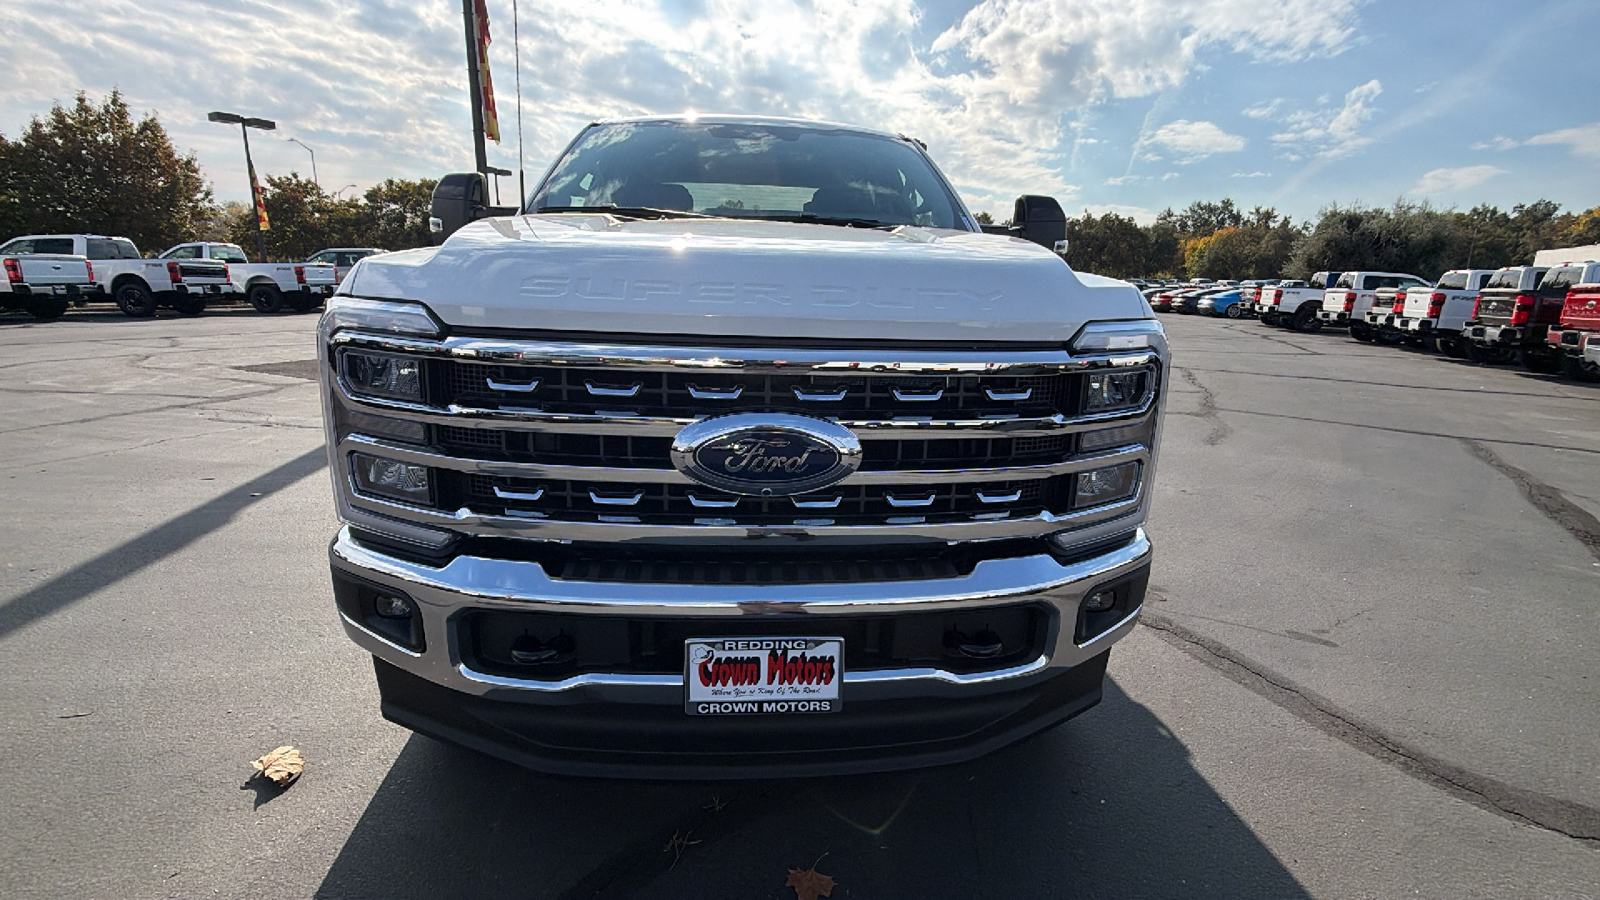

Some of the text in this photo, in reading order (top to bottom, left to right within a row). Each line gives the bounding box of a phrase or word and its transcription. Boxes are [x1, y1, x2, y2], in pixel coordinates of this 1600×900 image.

[519, 275, 1003, 311] SUPER DUTY
[724, 438, 811, 473] Ford
[724, 640, 806, 650] REDDING
[698, 650, 835, 687] Crown Motors
[711, 687, 732, 696] Where
[758, 687, 774, 696] King
[776, 686, 786, 695] Of
[788, 686, 800, 694] The
[698, 701, 831, 714] CROWN MOTORS
